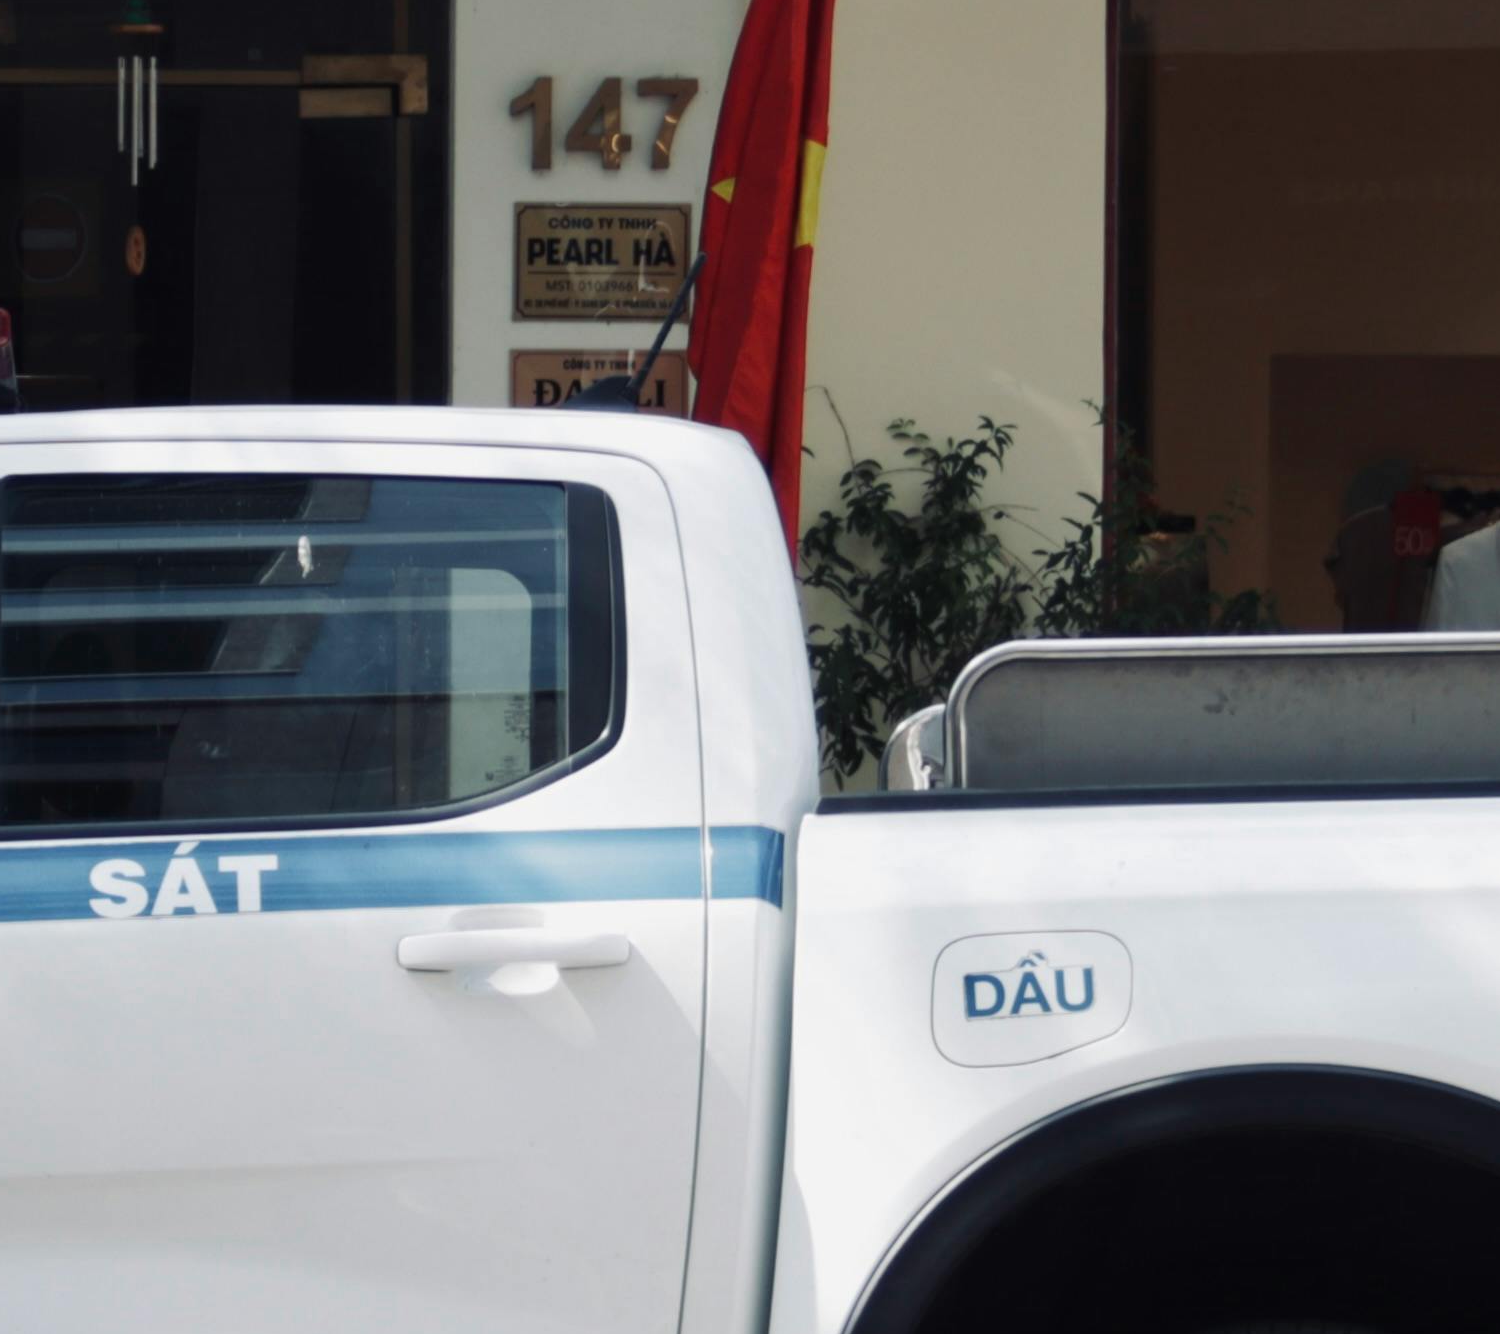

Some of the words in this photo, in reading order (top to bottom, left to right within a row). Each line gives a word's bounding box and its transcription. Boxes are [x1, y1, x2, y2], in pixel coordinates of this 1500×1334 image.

[509, 76, 699, 170] 147
[527, 237, 619, 266] PEARL
[632, 231, 676, 266] HÀ
[597, 218, 614, 230] TY
[88, 840, 279, 919] SÁT
[963, 949, 1094, 1018] DẦU
